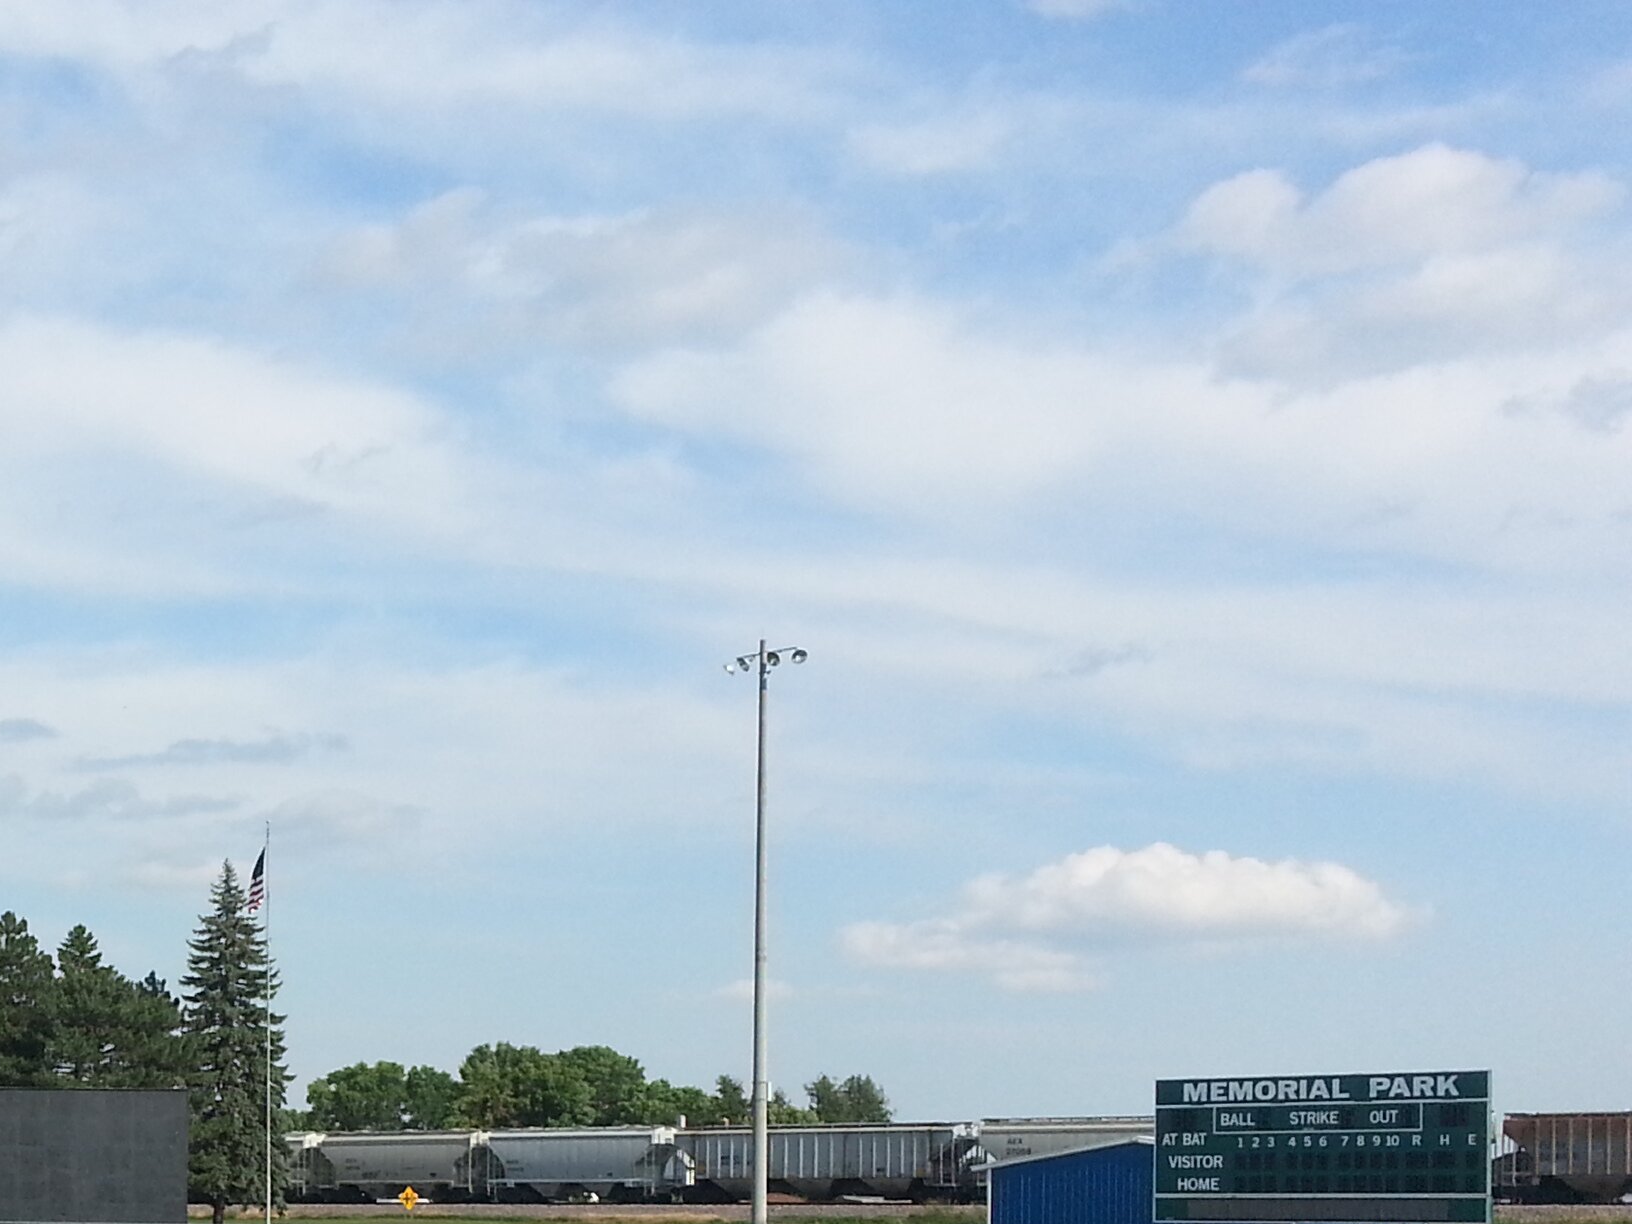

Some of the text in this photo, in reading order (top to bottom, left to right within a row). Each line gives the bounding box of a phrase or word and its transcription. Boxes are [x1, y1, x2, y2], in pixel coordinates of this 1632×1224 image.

[1182, 1075, 1459, 1102] MEMORIAL PARK
[1220, 1110, 1398, 1126] BALL STRIKE OUT
[1162, 1133, 1206, 1146] AT BAT
[1237, 1134, 1477, 1148] 1 2 3 4 5 6 7 8 9 10 R H E
[1168, 1155, 1224, 1168] VISITOR
[1177, 1178, 1220, 1191] HOME
